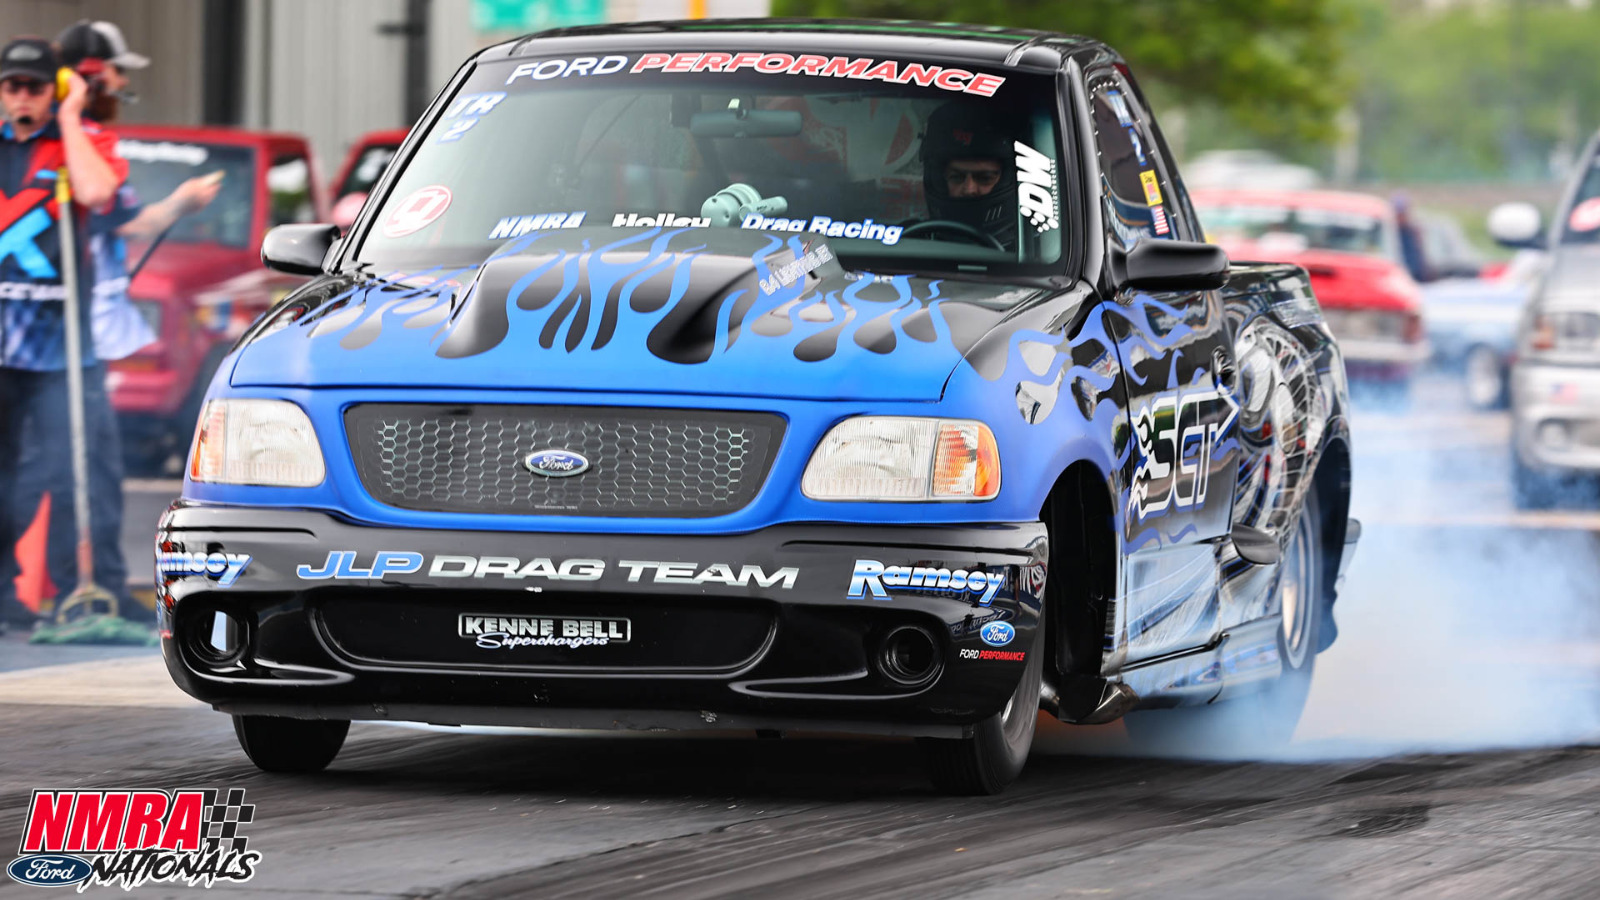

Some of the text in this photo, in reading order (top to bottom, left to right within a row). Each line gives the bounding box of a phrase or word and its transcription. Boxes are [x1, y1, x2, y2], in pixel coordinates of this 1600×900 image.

[505, 53, 1006, 97] FORD PERFORMANCE
[488, 211, 587, 239] NMRA
[807, 215, 904, 245] Racing
[539, 454, 574, 470] Ford
[296, 551, 800, 589] JLP DRAG TEAM
[847, 559, 1006, 607] Ramsey
[465, 616, 623, 639] KENNE BELL
[987, 626, 1010, 643] Ford
[476, 632, 610, 650] Superchargers
[959, 649, 1026, 661] FORD PERFORMANCE
